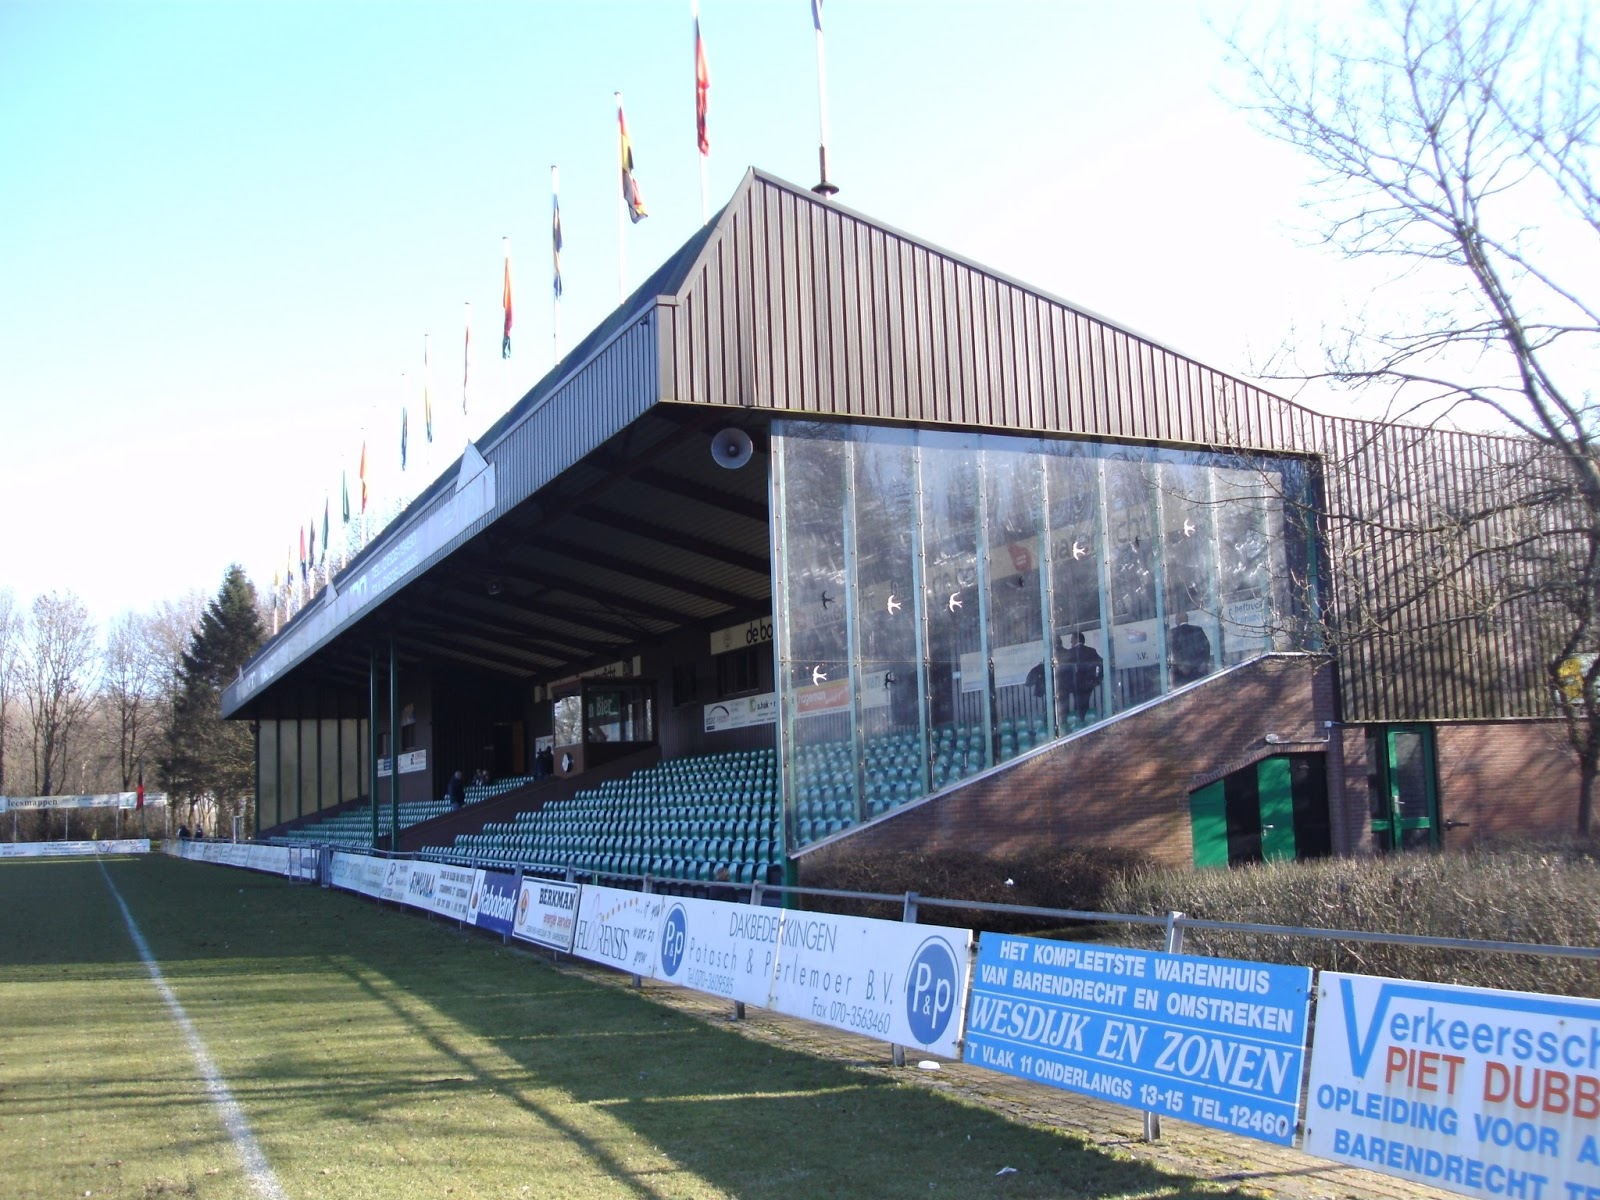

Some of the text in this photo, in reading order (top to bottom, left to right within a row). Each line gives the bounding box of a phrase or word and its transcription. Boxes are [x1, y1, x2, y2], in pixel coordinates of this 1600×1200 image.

[7, 799, 58, 808] leesmappen
[480, 883, 517, 922] Rabobank
[538, 887, 576, 911] BERKMAN
[729, 911, 837, 953] DAKBEDEKKINGEN
[746, 947, 753, 974] &
[764, 950, 852, 995] Perlemoer
[1000, 940, 1270, 995] HET KOMPLEETSTE WARENHUIS
[811, 997, 891, 1034] Fax 070-3563460
[981, 964, 1294, 1033] VAN BARENDRECHT EN OMSTREKEN
[971, 995, 1294, 1095] WESDIJK EN ZONEN
[982, 1045, 1015, 1069] VLAK
[1020, 1055, 1032, 1073] 11
[1035, 1058, 1133, 1100] ONDERLANGS
[1140, 1083, 1184, 1112] 13-15
[1385, 1045, 1600, 1120] PIET DUBB
[1316, 1083, 1458, 1136] OPLEIDING
[1474, 1112, 1561, 1158] VOOR
[1333, 1128, 1549, 1200] BARENDRECHT
